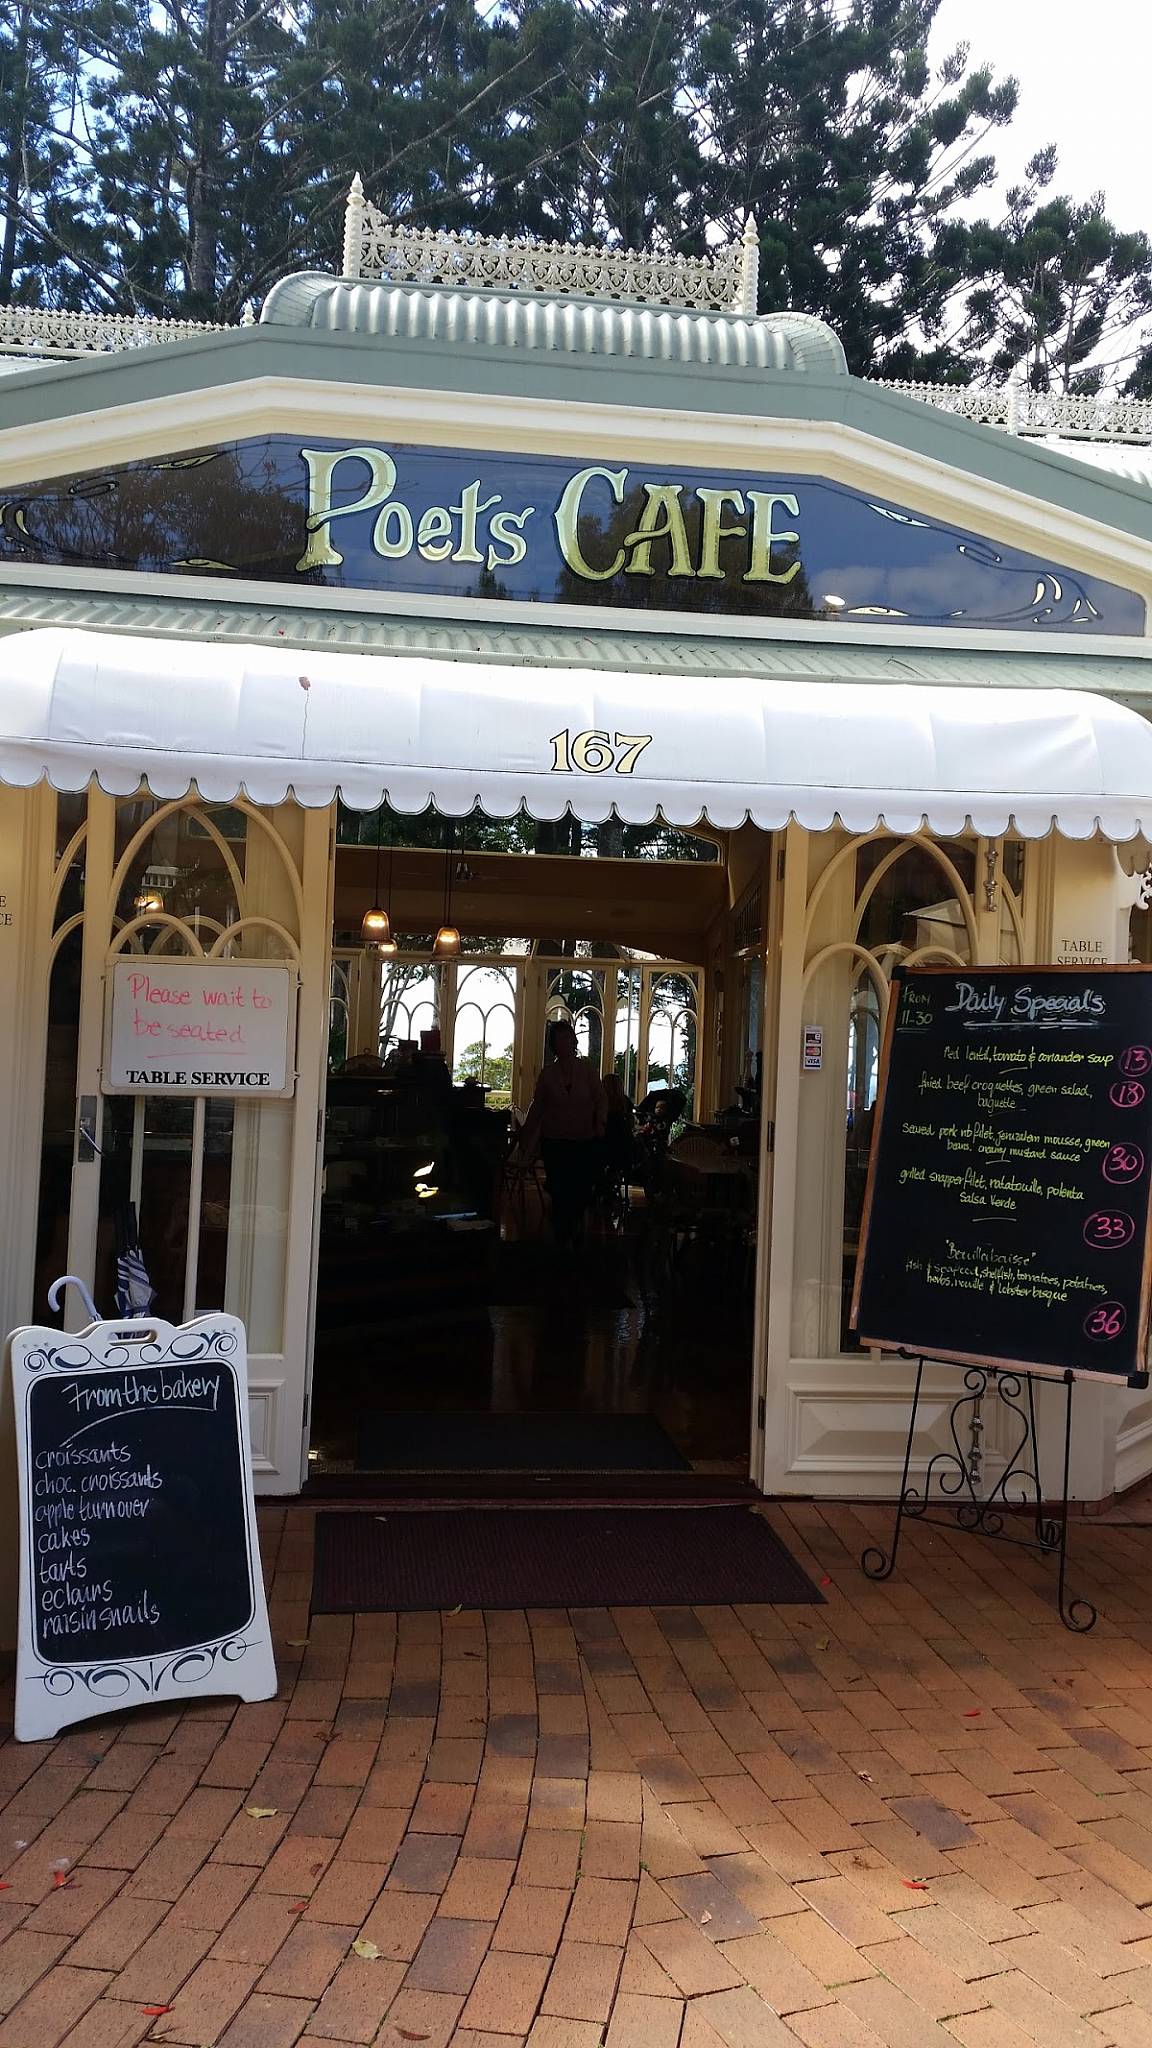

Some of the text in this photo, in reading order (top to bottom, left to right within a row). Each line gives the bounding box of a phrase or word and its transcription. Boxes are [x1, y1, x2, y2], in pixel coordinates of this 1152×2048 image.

[295, 446, 801, 585] Poets CAFE
[549, 728, 653, 775] 167
[1061, 939, 1103, 952] TABLE
[127, 972, 273, 1009] Please wait to
[945, 981, 1106, 1021] Daily Specials
[133, 1008, 246, 1044] be seated
[992, 1045, 1027, 1063] tomato
[1037, 1051, 1085, 1063] coriander
[1087, 1053, 1115, 1068] soup
[1123, 1049, 1148, 1071] 13
[126, 1070, 270, 1086] TABLE SERVICE
[918, 1071, 943, 1096] fried
[946, 1073, 971, 1095] beef
[1027, 1083, 1058, 1098] green
[1060, 1082, 1094, 1099] salad,
[977, 1092, 1016, 1113] baguette
[1118, 1083, 1140, 1104] 18
[938, 1123, 958, 1140] pork
[960, 1123, 973, 1138] rib
[1044, 1135, 1083, 1149] mousse,
[1085, 1138, 1111, 1153] green
[1009, 1147, 1047, 1160] mustard
[1050, 1151, 1081, 1163] sauce
[1109, 1146, 1138, 1171] 30
[899, 1167, 926, 1185] grilled
[928, 1172, 965, 1189] snapper
[1046, 1182, 1085, 1200] polenta
[959, 1191, 1017, 1210] Salsa Verde
[1094, 1217, 1126, 1240] 33
[998, 1281, 1032, 1297] lobster
[1032, 1285, 1069, 1308] bisque
[1090, 1309, 1122, 1335] 36
[61, 1370, 221, 1413] From the bakery
[34, 1441, 132, 1469] croissants
[34, 1464, 163, 1496] choc. croissants
[34, 1498, 150, 1528] apple turnover
[37, 1526, 91, 1554] cakes
[38, 1554, 88, 1584] tarts
[41, 1579, 114, 1612] eclairs
[42, 1589, 161, 1639] raisin snails
